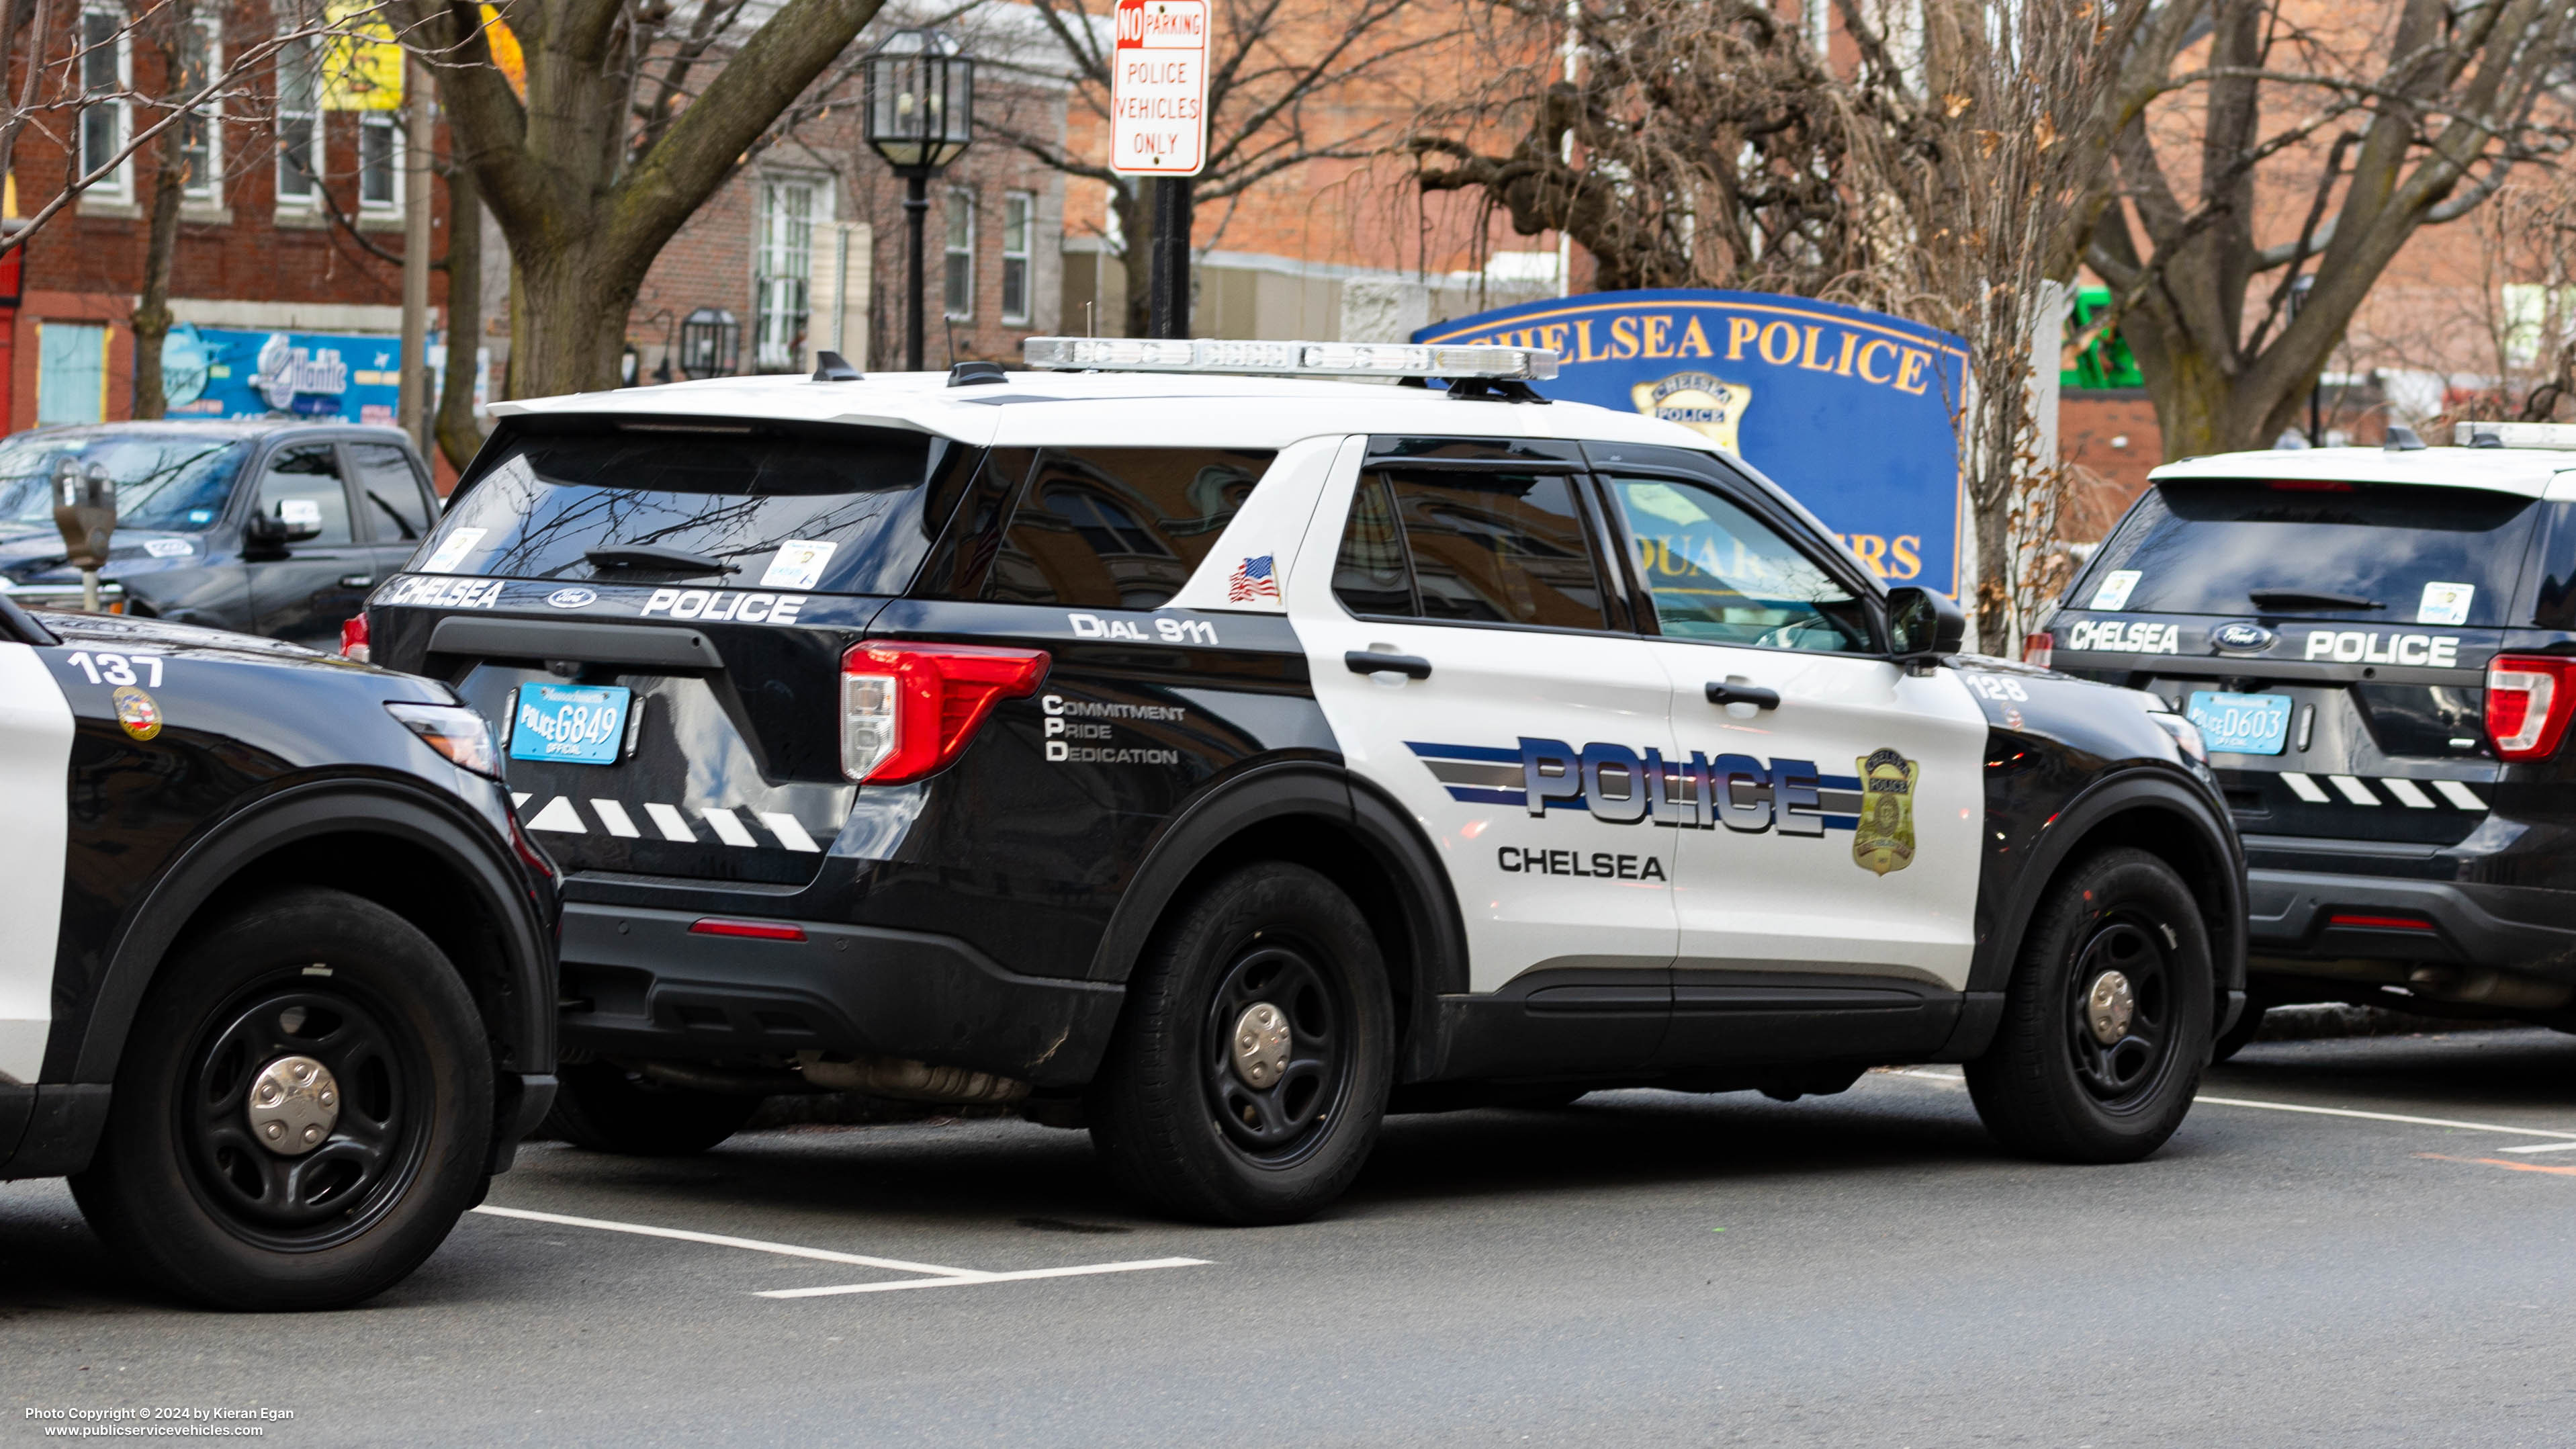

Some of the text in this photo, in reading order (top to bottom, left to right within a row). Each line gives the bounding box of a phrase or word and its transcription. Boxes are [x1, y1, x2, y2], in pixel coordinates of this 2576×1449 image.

[1118, 7, 1200, 41] NO PARKING
[1128, 62, 1186, 83] POLICE
[1116, 97, 1199, 119] VEHICLES
[1134, 132, 1178, 154] ONLY
[1724, 317, 1933, 396] POLICE
[1656, 408, 1725, 423] POLICE
[390, 576, 506, 609] CHELSEA
[639, 588, 807, 625] POLICE
[1155, 617, 1219, 646] 911
[2069, 620, 2180, 654] CHELSEA
[2305, 630, 2460, 668] POLICE
[66, 651, 163, 688] 137
[1966, 674, 2029, 701] 128
[521, 704, 617, 745] POLICE G849
[2223, 707, 2282, 739] D603
[1517, 736, 1824, 838] POLICE
[1498, 846, 1667, 881] CHELSEA
